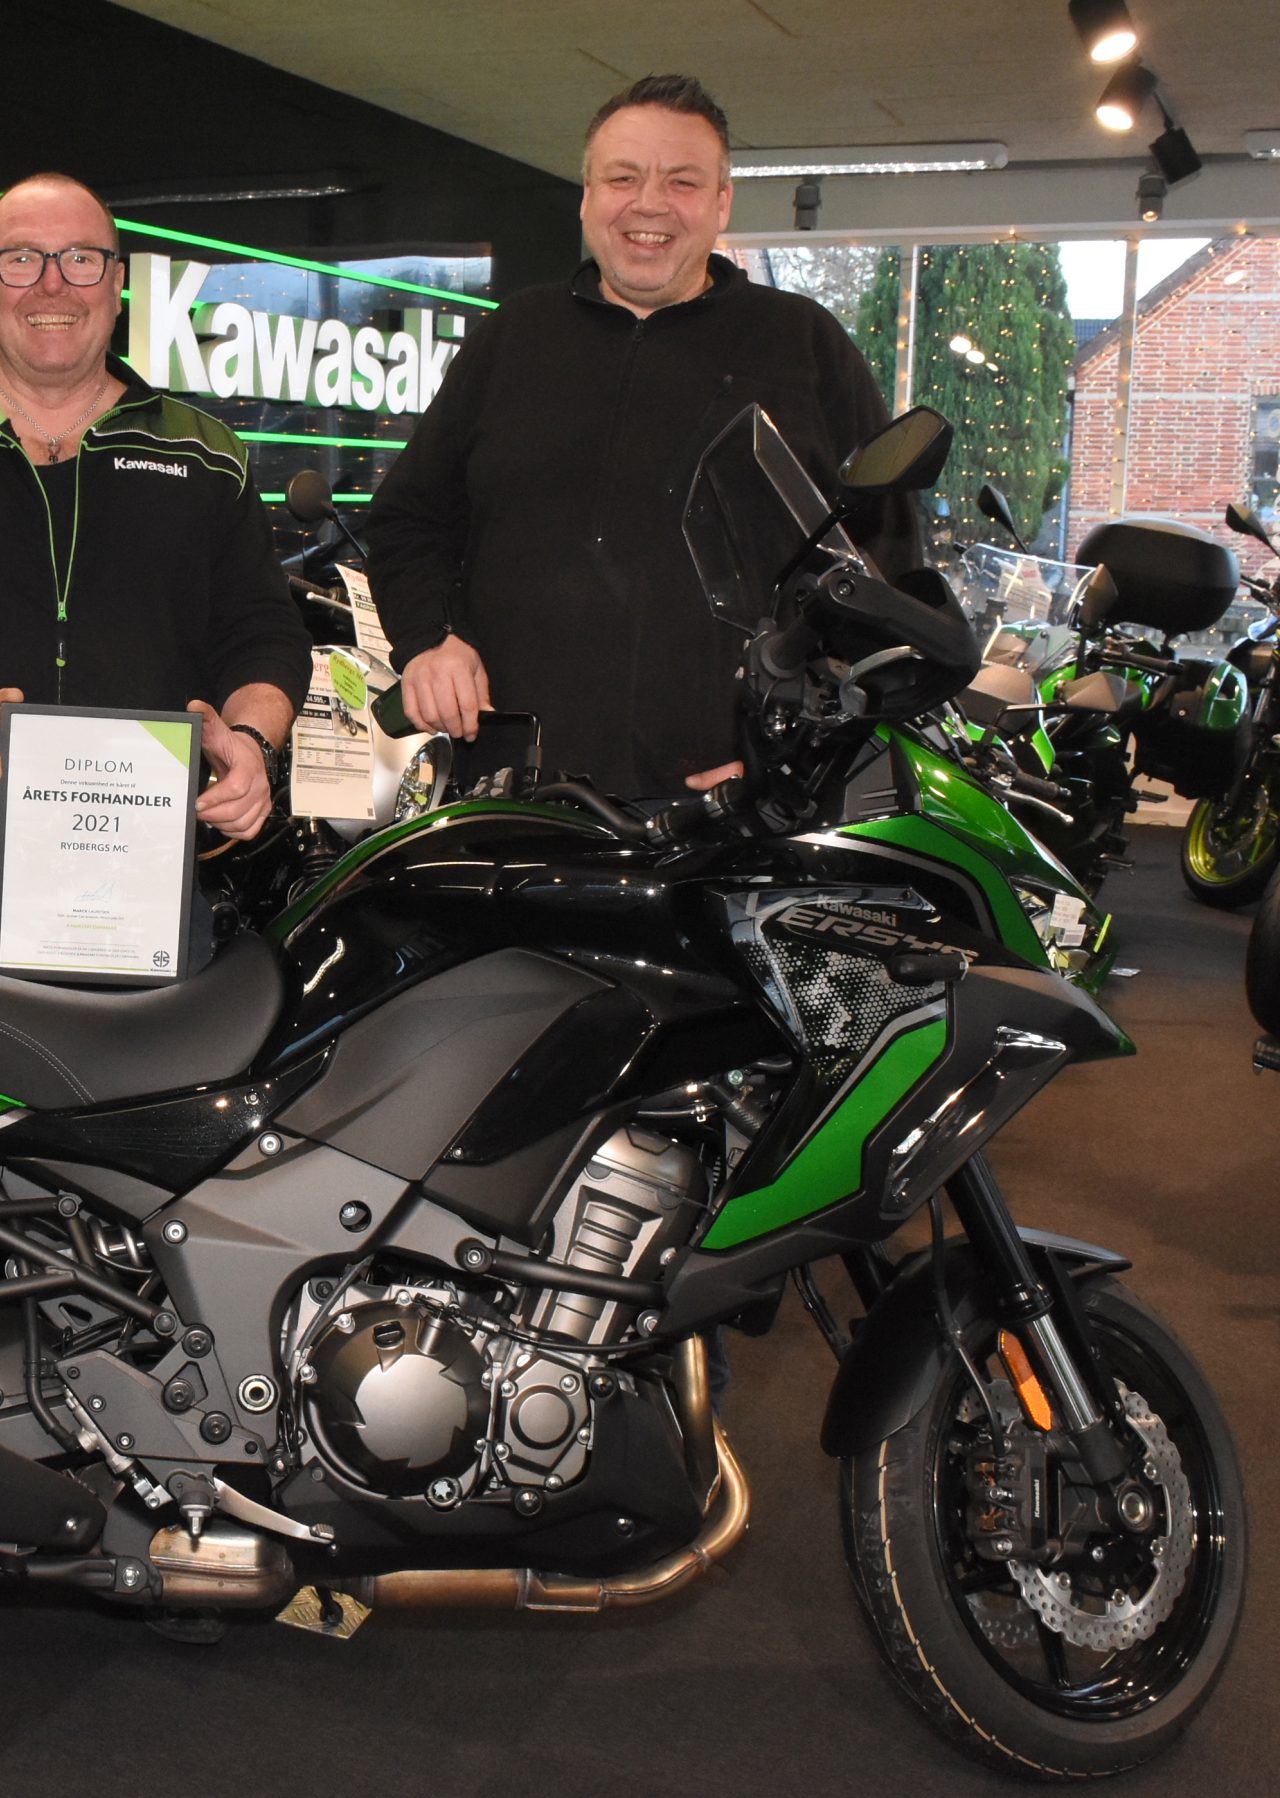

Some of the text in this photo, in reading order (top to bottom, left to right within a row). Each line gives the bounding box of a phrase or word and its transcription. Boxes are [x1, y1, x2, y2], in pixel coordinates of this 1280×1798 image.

[113, 457, 188, 478] Kawasaki
[64, 758, 134, 774] DIPLOM
[22, 785, 173, 808] ÅRETS FORHANDLER
[72, 814, 121, 833] 2021
[60, 842, 129, 853] RYDBERGS MC
[816, 894, 897, 927] Kawasaki
